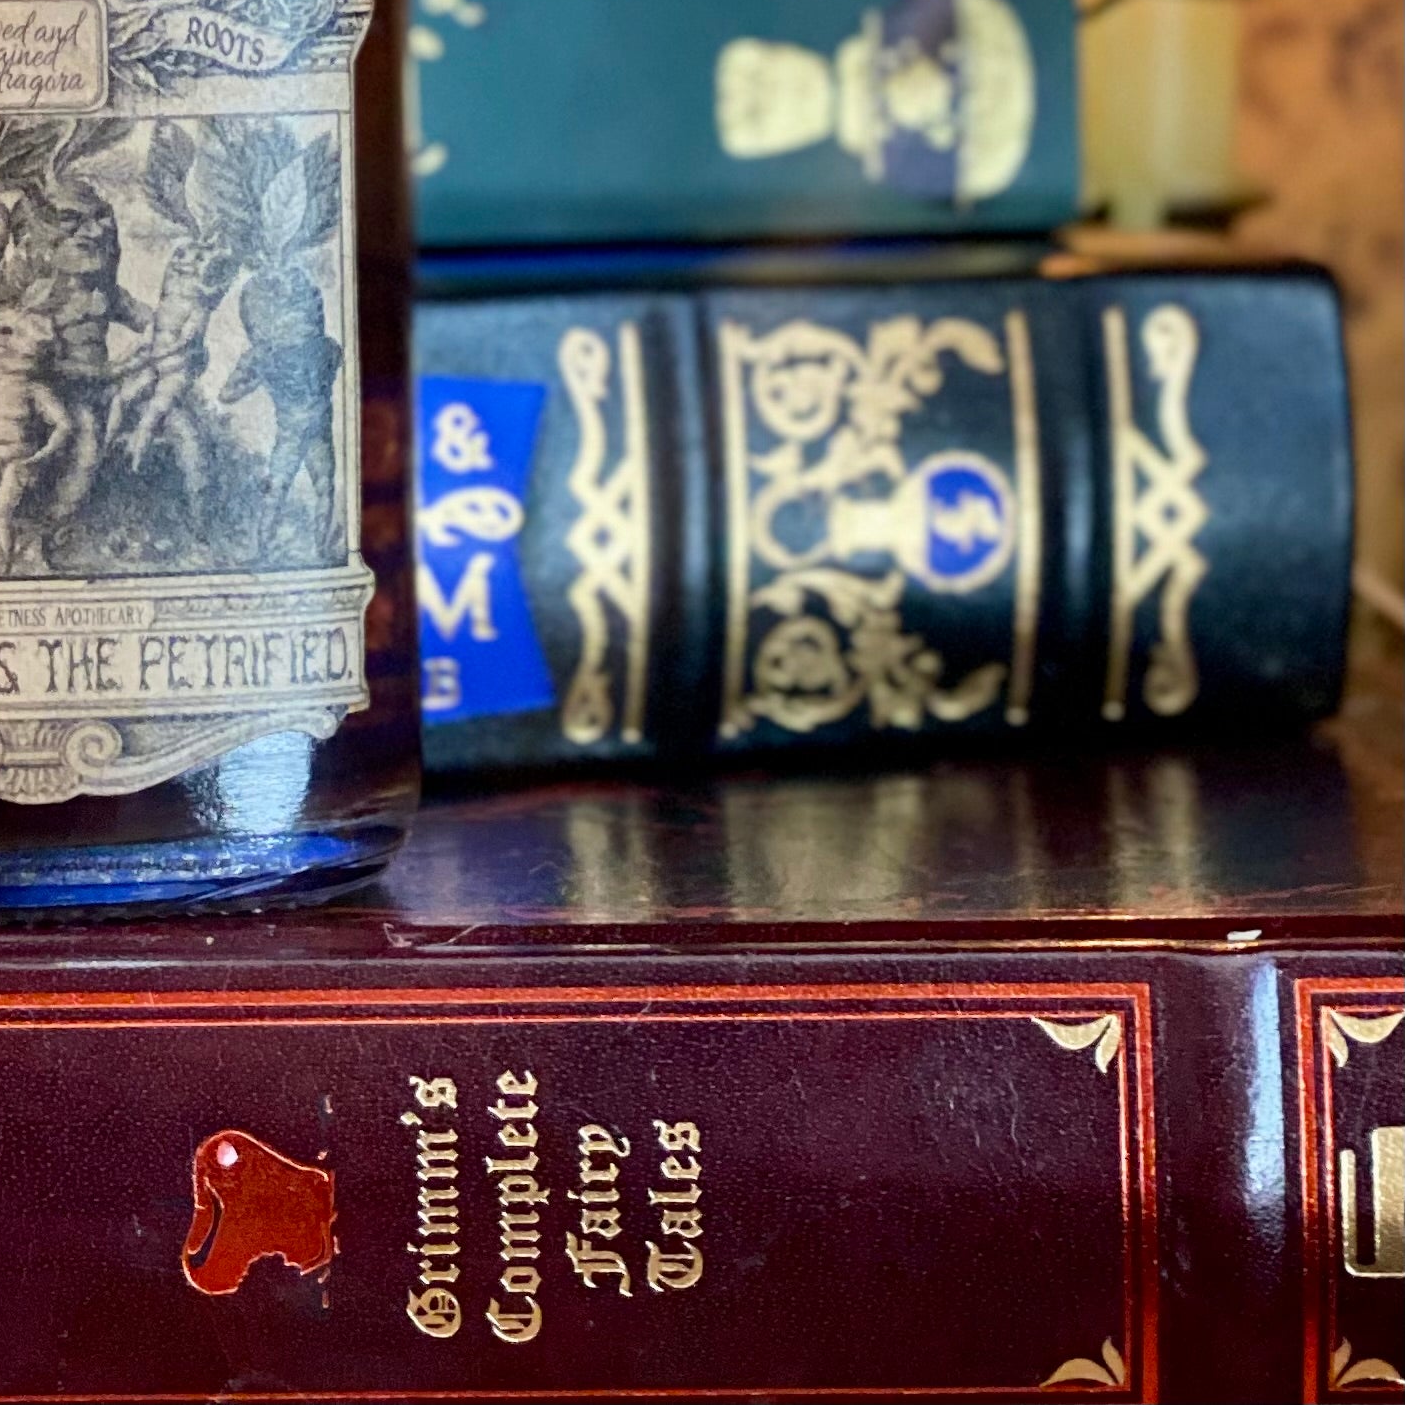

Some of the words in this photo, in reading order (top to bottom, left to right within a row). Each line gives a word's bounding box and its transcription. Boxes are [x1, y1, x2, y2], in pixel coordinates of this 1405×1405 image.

[34, 7, 88, 48] and
[185, 15, 264, 67] ROOTS
[37, 636, 124, 693] THE
[139, 625, 354, 692] PETRIFIED.
[399, 1077, 463, 1339] Grimm's
[482, 1069, 551, 1343] Complete
[565, 1123, 634, 1298] Fairy
[644, 1118, 705, 1294] Tales
